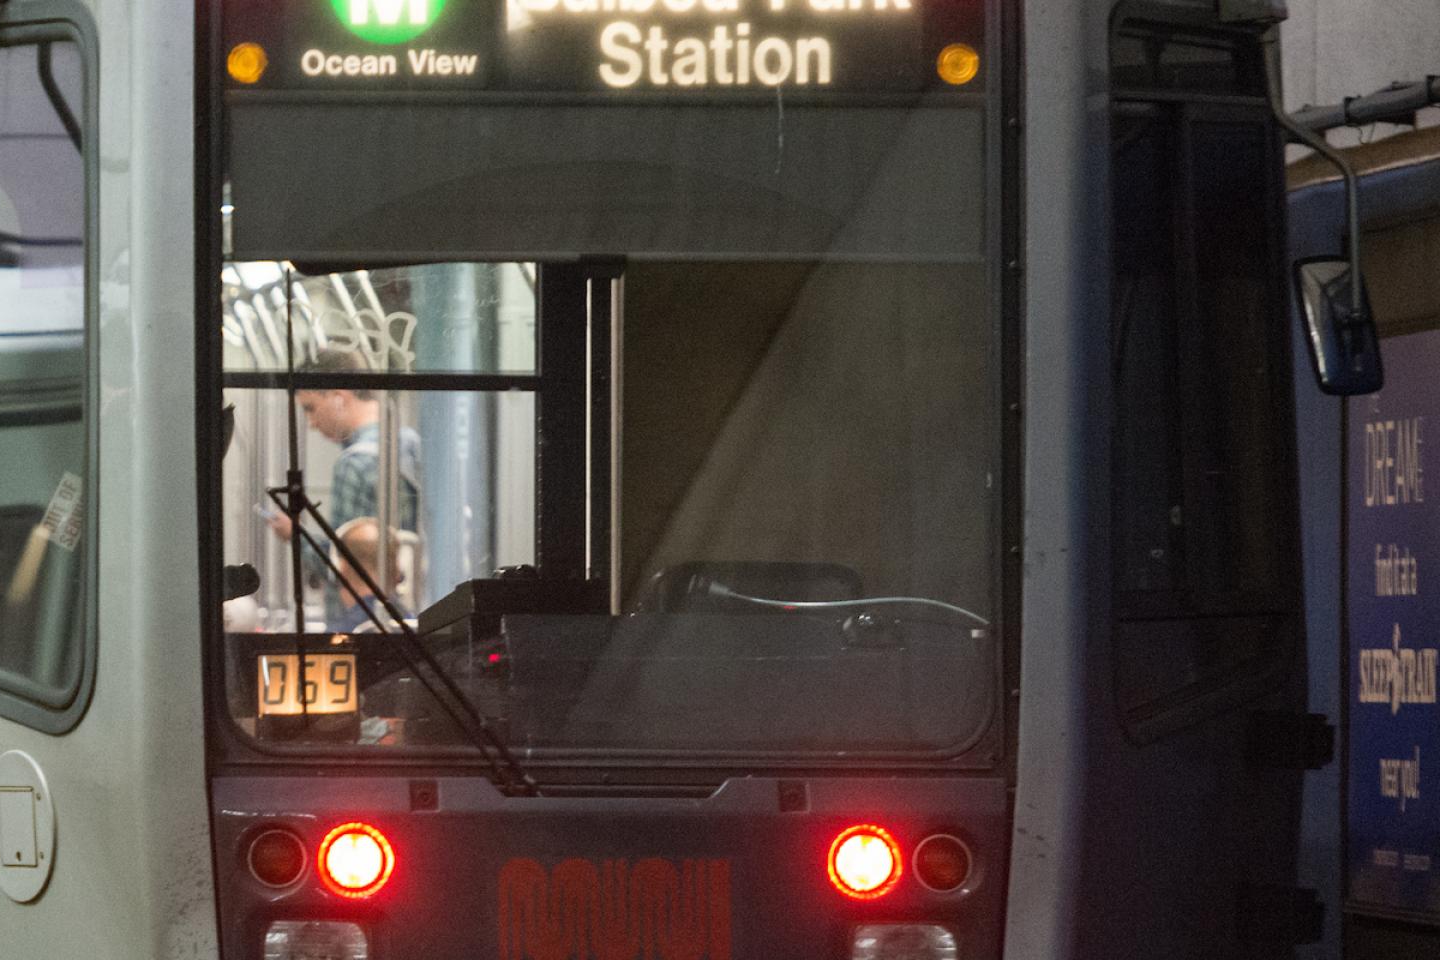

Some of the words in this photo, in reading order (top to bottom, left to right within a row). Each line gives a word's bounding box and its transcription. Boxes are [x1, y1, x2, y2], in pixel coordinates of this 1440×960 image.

[301, 49, 397, 76] Ocean
[408, 49, 478, 75] View
[599, 20, 832, 88] Station
